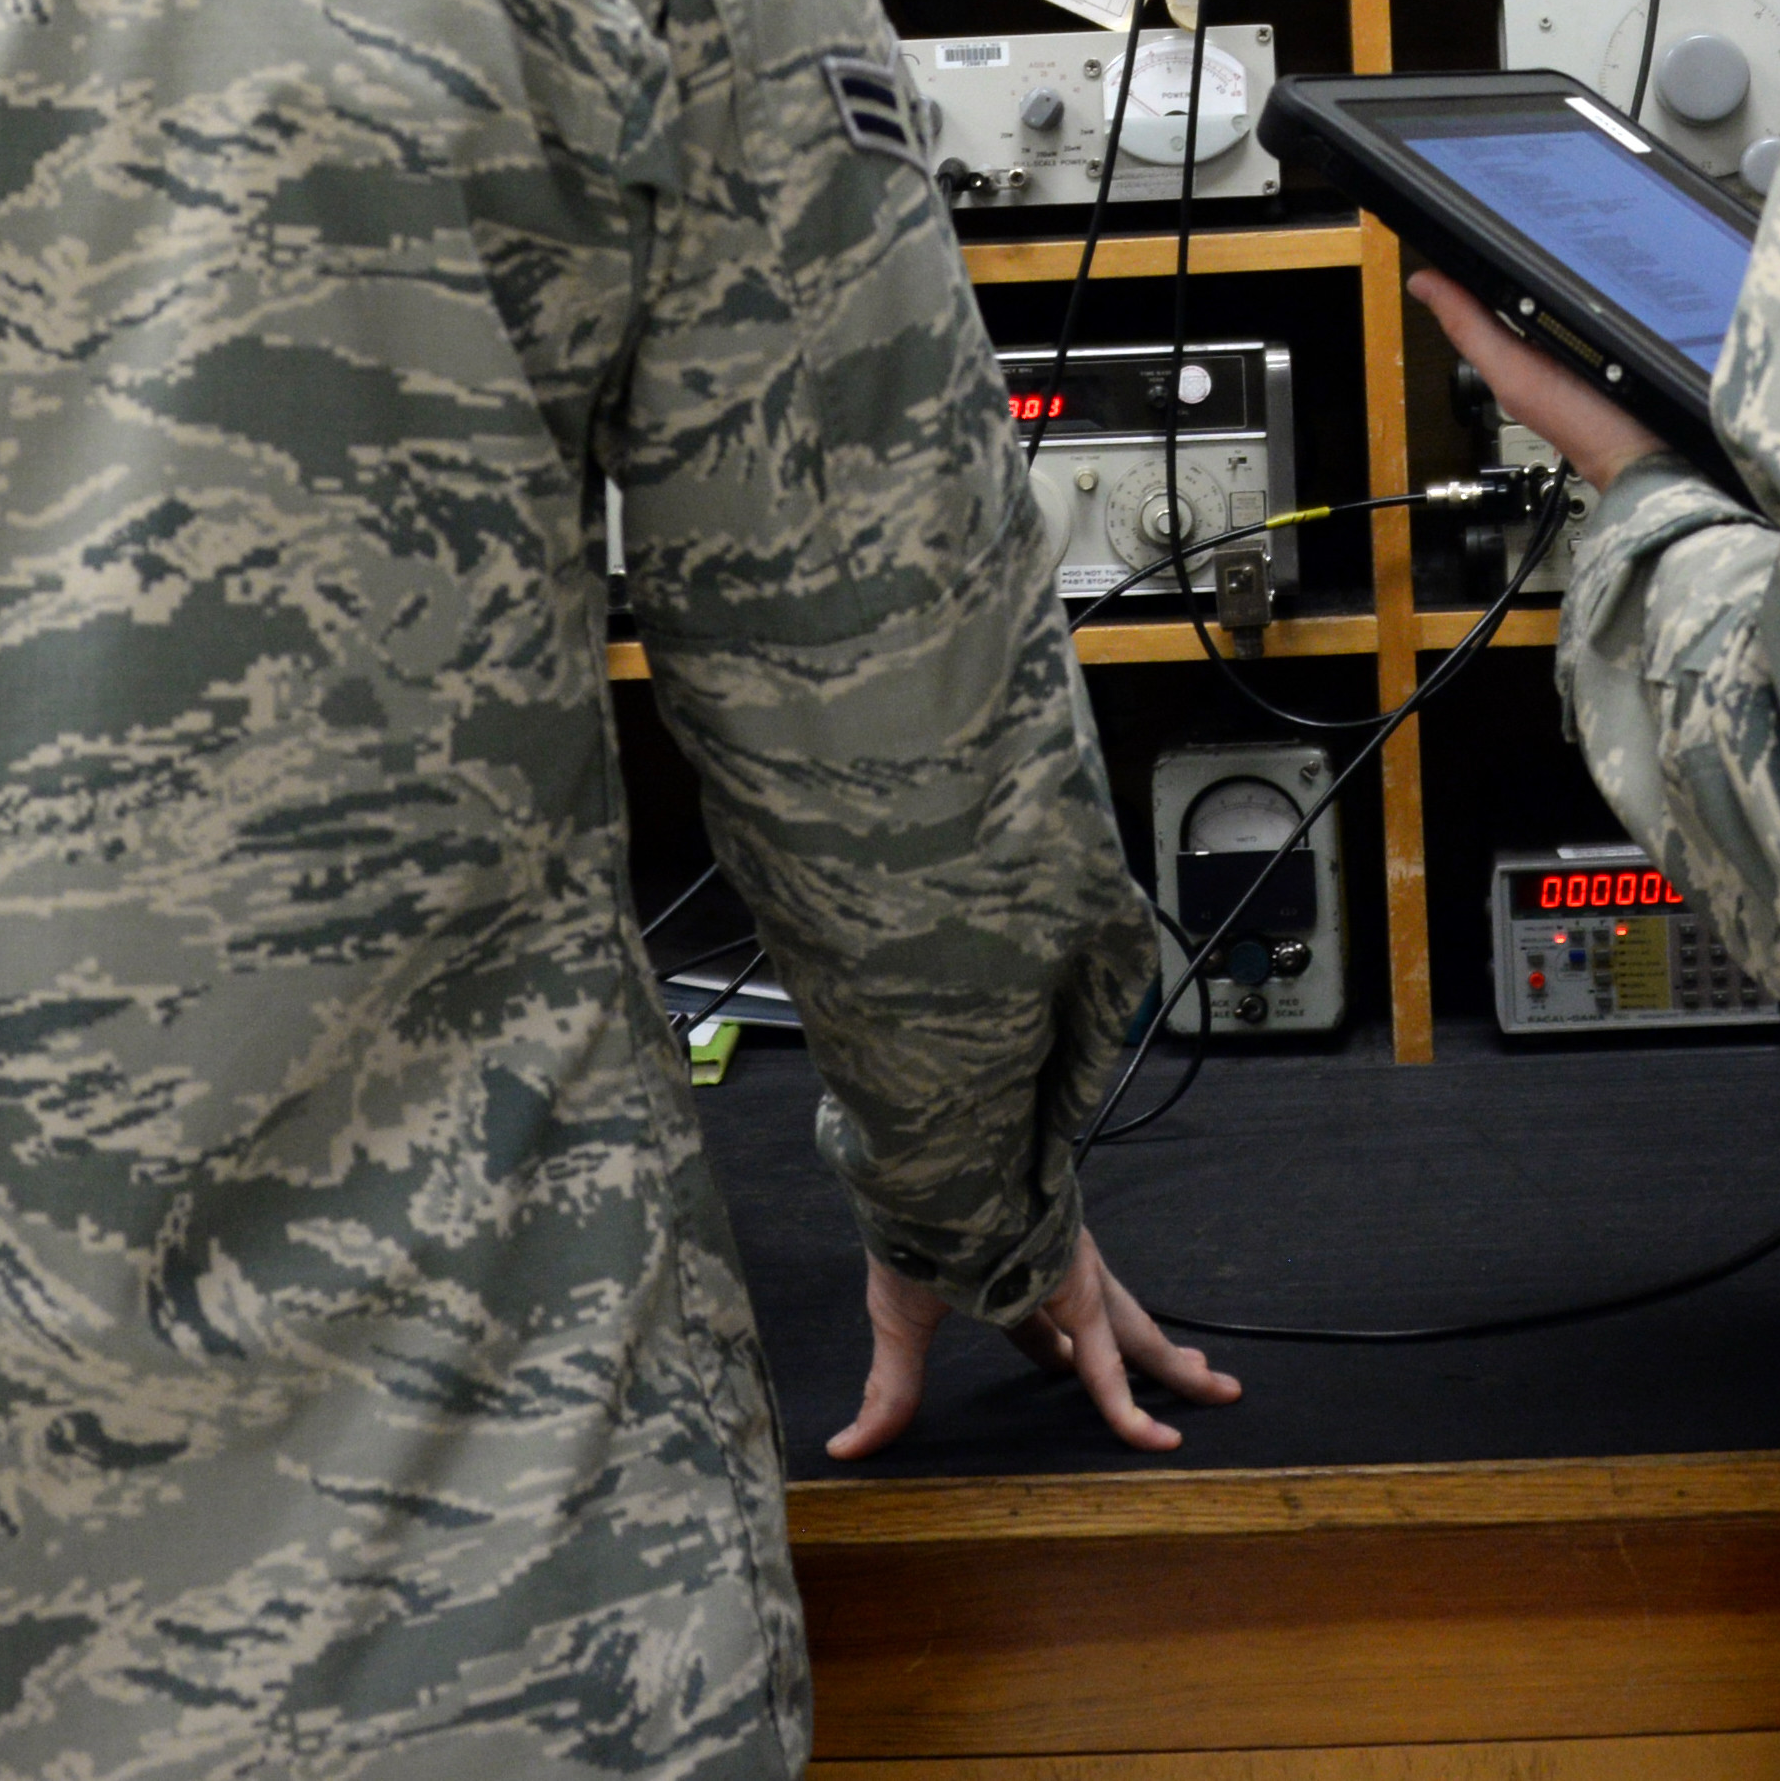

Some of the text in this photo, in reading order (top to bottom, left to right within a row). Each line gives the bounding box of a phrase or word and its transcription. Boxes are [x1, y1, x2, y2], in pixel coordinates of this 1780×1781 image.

[1105, 569, 1129, 577] TURN
[1062, 578, 1085, 586] PAST
[1212, 999, 1230, 1008] ACK
[1279, 998, 1299, 1007] RED
[1276, 1008, 1305, 1018] SCALE
